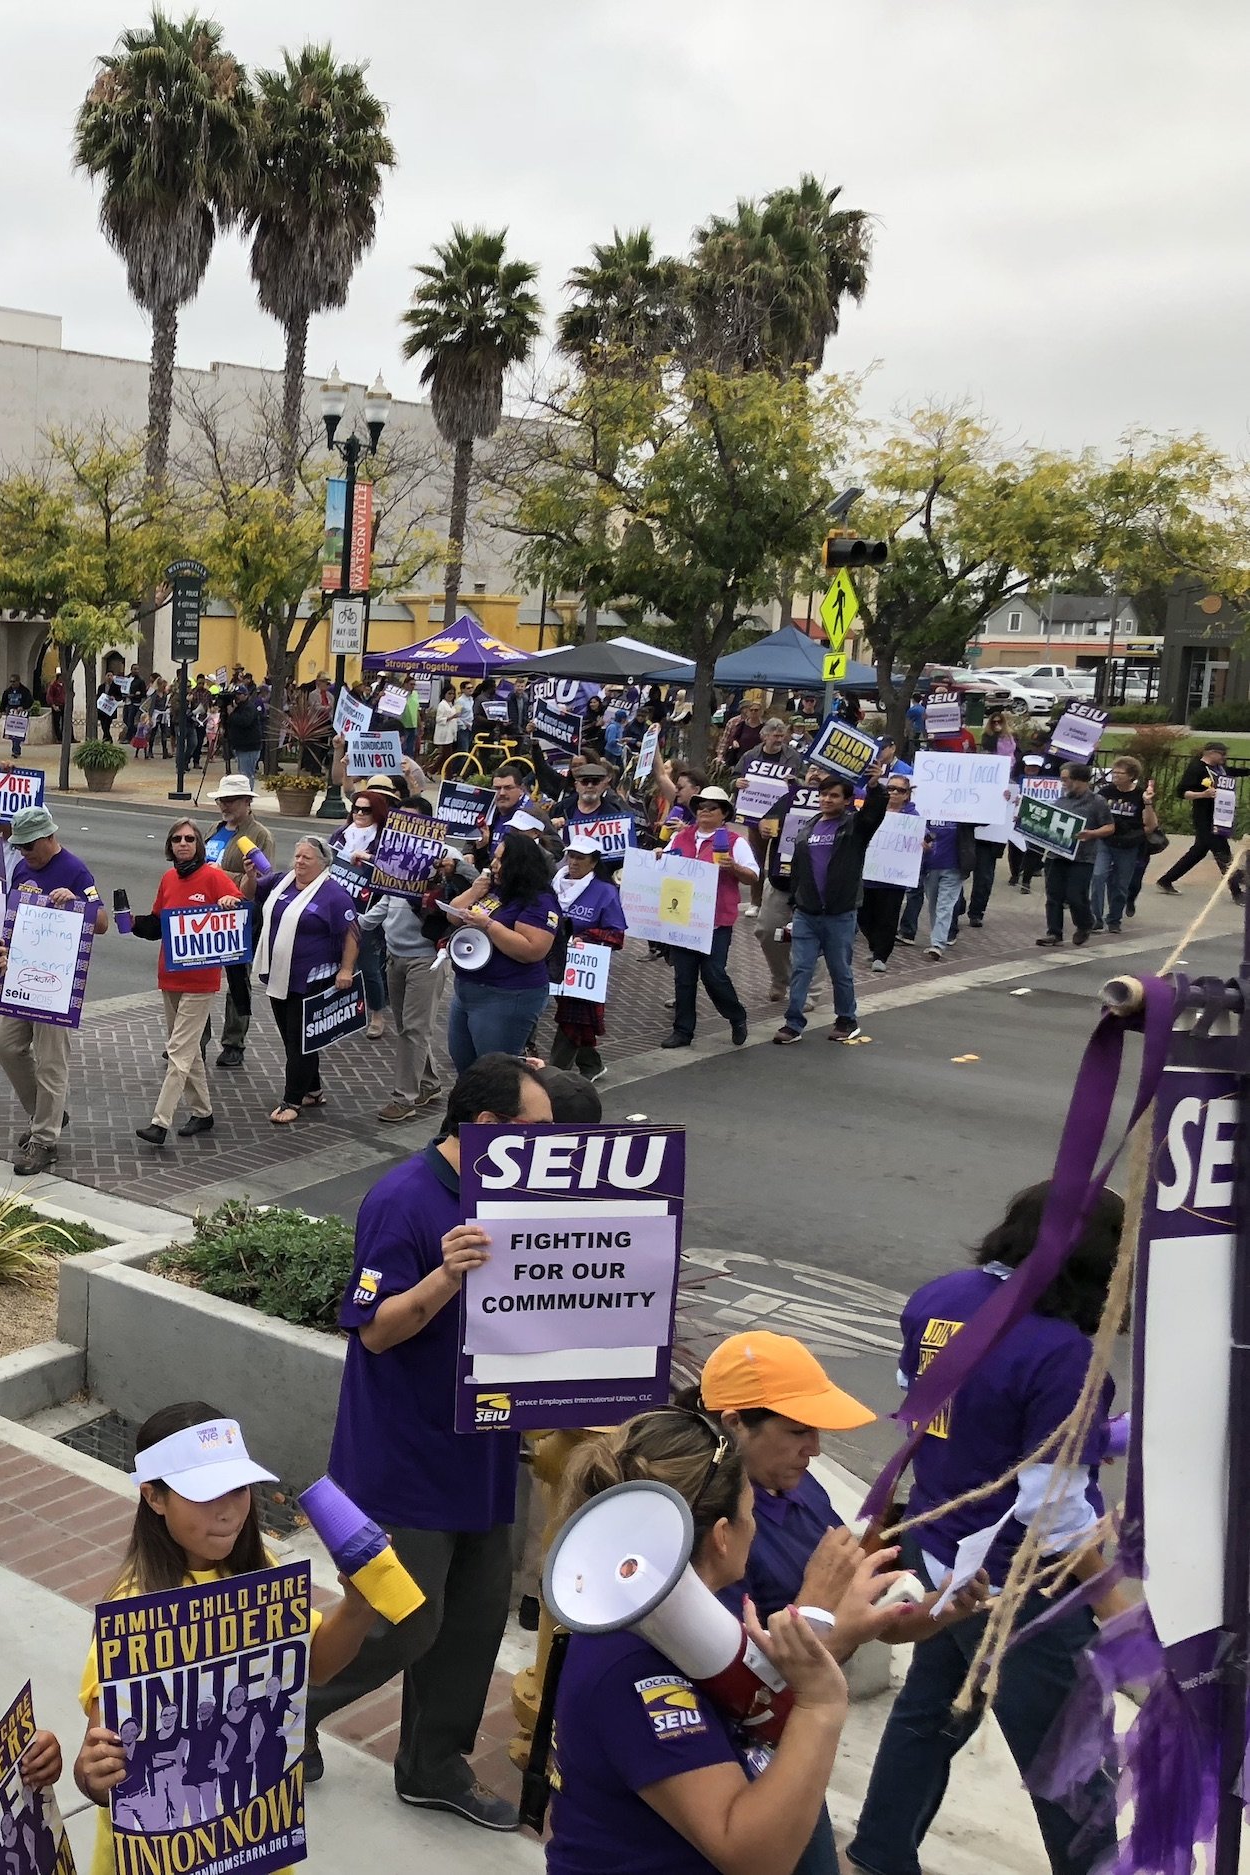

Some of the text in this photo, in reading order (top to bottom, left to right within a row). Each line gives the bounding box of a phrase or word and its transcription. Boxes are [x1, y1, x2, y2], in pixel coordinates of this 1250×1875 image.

[355, 484, 367, 588] WATSONVILLE
[168, 561, 207, 577] WATSONVILLE
[336, 628, 357, 637] MAY USE
[333, 639, 359, 649] FULL LANE
[384, 659, 459, 673] Stronger Together
[409, 672, 432, 681] SEIU
[385, 684, 409, 697] SEIU
[534, 677, 556, 700] SEIU
[608, 698, 633, 710] SEIU
[927, 692, 957, 704] SEIU
[1067, 703, 1108, 721] SEIU
[361, 741, 393, 751] SINDICATO
[830, 729, 872, 762] UNION
[353, 754, 396, 768] MI VOTO
[823, 744, 865, 773] STRONG
[748, 760, 792, 778] SEIU
[1217, 776, 1235, 789] SEIU
[793, 789, 819, 807] SE
[942, 788, 980, 804] 2015
[1023, 788, 1060, 800] UNION
[1028, 803, 1047, 818] YES
[386, 818, 447, 841] PROVIDERS
[388, 811, 449, 830] FAMILY CHILD CARE
[574, 824, 580, 835] I
[1050, 811, 1076, 848] H
[383, 829, 447, 859] UNITED
[372, 867, 406, 888] UNION
[18, 905, 66, 923] Unions
[570, 904, 594, 918] 2015
[179, 914, 185, 934] I
[22, 920, 73, 950] Fighting
[175, 930, 240, 957] UNION
[313, 991, 358, 1020] ME QUEDO CON MI
[481, 1135, 667, 1190] SEIU
[1156, 1096, 1237, 1213] SE
[511, 1231, 632, 1250] FIGHTING
[514, 1263, 625, 1280] FOR OUR
[481, 1292, 655, 1314] COMMMUNITY
[515, 1399, 538, 1407] Service
[539, 1396, 573, 1406] Employees
[574, 1395, 615, 1404] International
[615, 1395, 637, 1403] Union,
[475, 1411, 509, 1423] SEIU
[197, 1427, 217, 1435] TOGETHER
[199, 1433, 218, 1443] we
[100, 1574, 308, 1639] FAMILY CHILD CARE
[102, 1597, 308, 1680] PROVIDERS
[103, 1640, 307, 1742] UNITED
[639, 1677, 672, 1691] LOCAL
[1, 1691, 30, 1741] CARE
[653, 1710, 701, 1733] SEIU
[114, 1760, 305, 1875] UNION NOW!
